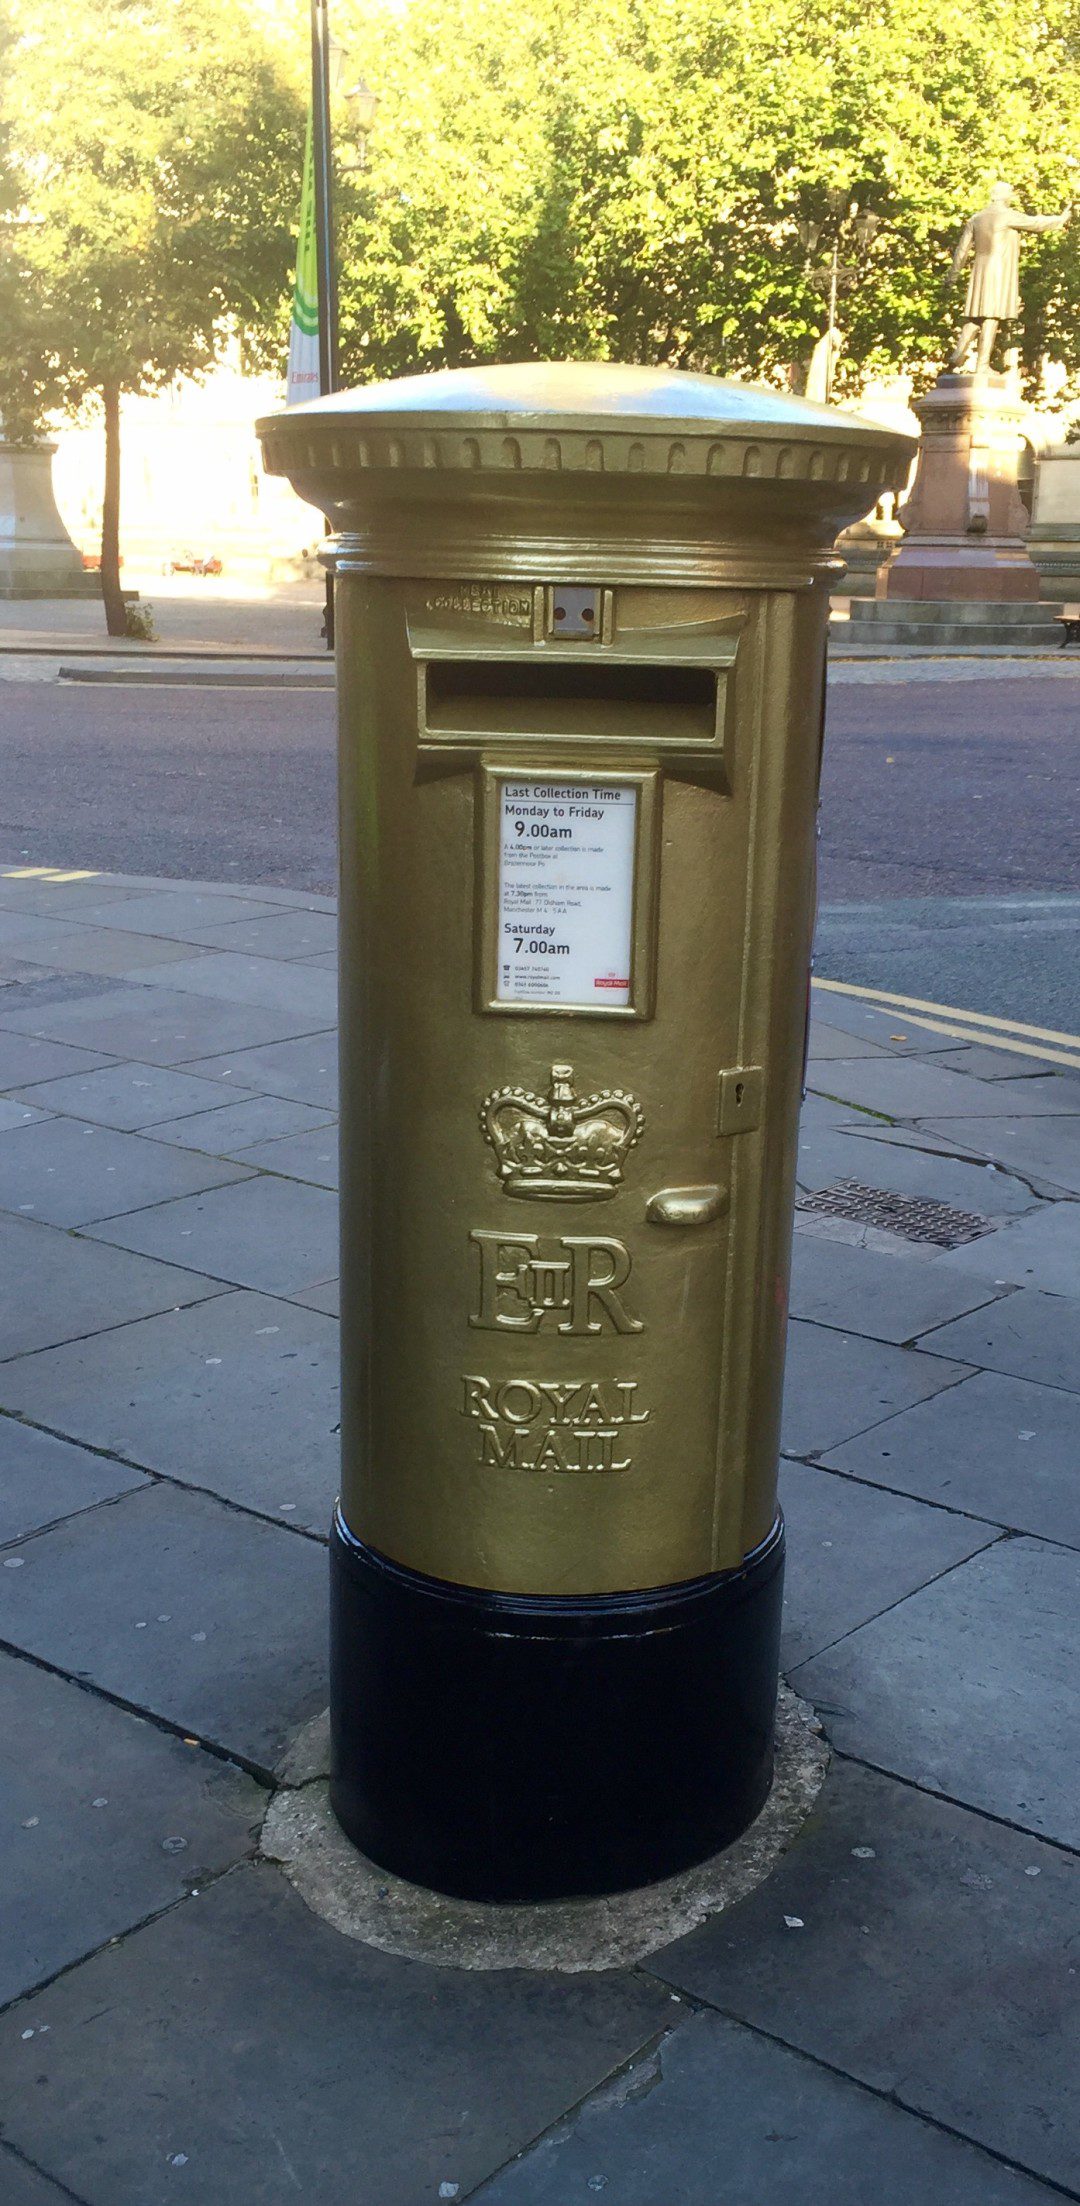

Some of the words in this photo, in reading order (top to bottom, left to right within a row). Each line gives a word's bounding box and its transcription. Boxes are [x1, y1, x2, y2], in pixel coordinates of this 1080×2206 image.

[291, 371, 318, 383] Emirates
[505, 787, 530, 798] Last
[533, 787, 589, 799] Collection
[592, 789, 621, 800] Time
[505, 805, 549, 819] Monday
[553, 807, 565, 817] to
[569, 807, 604, 820] Friday
[514, 821, 572, 838] 9.00am
[532, 883, 557, 891] collection
[504, 923, 555, 937] Saturday
[513, 938, 570, 955] 7.00am
[458, 1374, 650, 1427] ROYAL
[479, 1423, 632, 1474] MAIL
